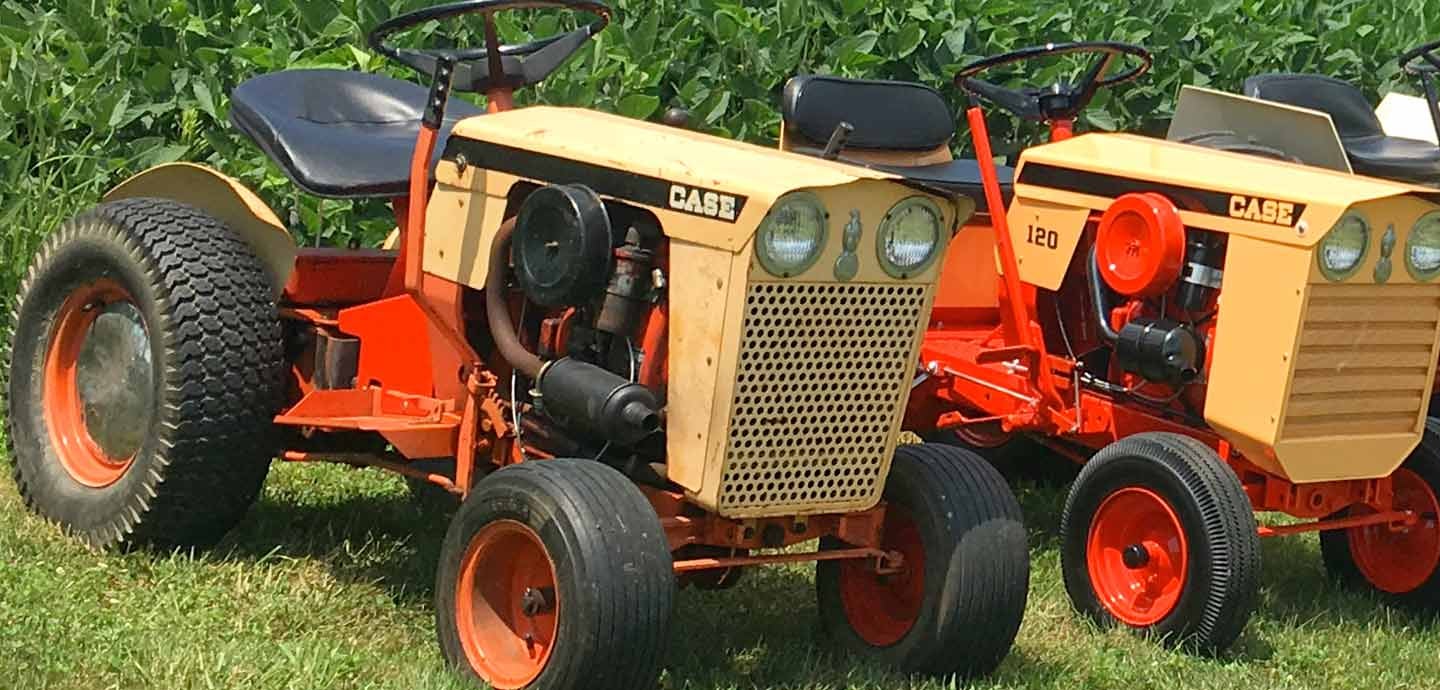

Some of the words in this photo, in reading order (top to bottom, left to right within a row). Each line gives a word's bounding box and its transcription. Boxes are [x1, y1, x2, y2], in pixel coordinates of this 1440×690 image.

[669, 184, 736, 220] CASE
[1229, 195, 1294, 226] CASE
[1027, 224, 1058, 250] 120
